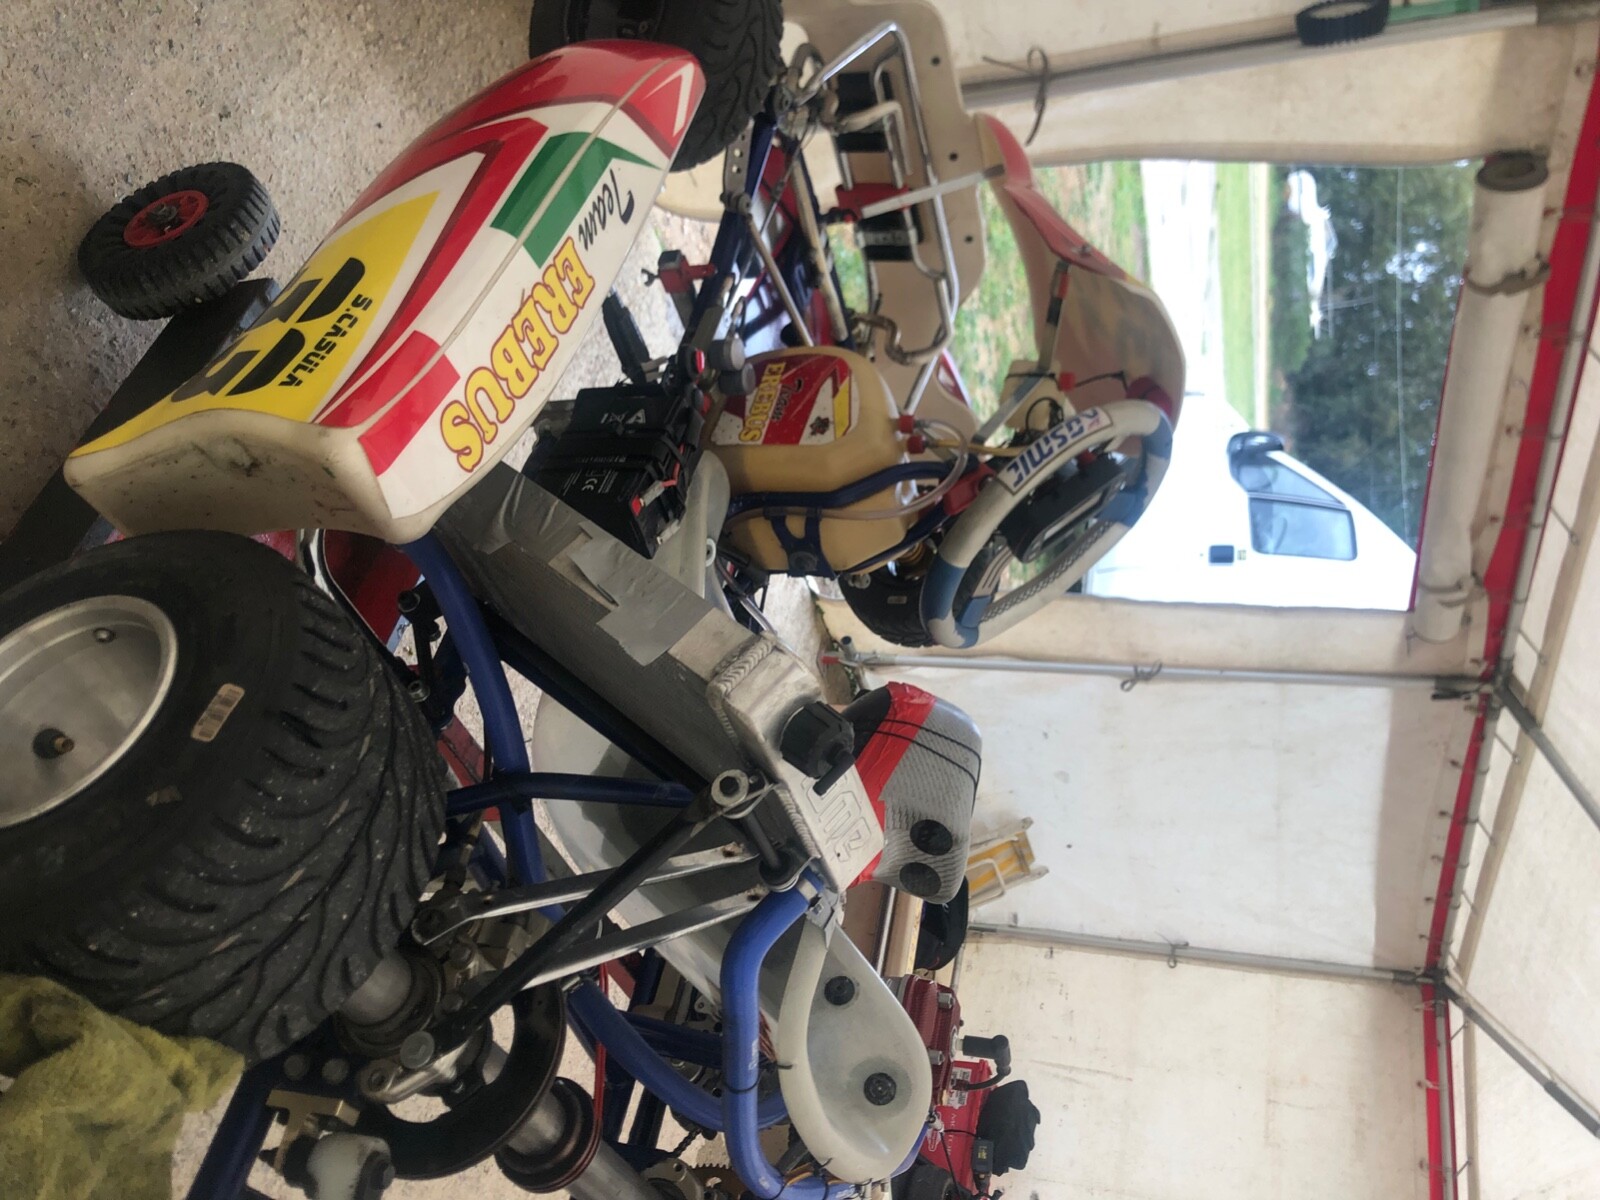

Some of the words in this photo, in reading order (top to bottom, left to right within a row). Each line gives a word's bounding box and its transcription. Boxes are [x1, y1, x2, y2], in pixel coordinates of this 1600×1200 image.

[578, 168, 635, 251] Team
[277, 293, 373, 387] S.CASULA
[439, 236, 596, 473] EREBUS
[739, 361, 787, 442] EREBUS
